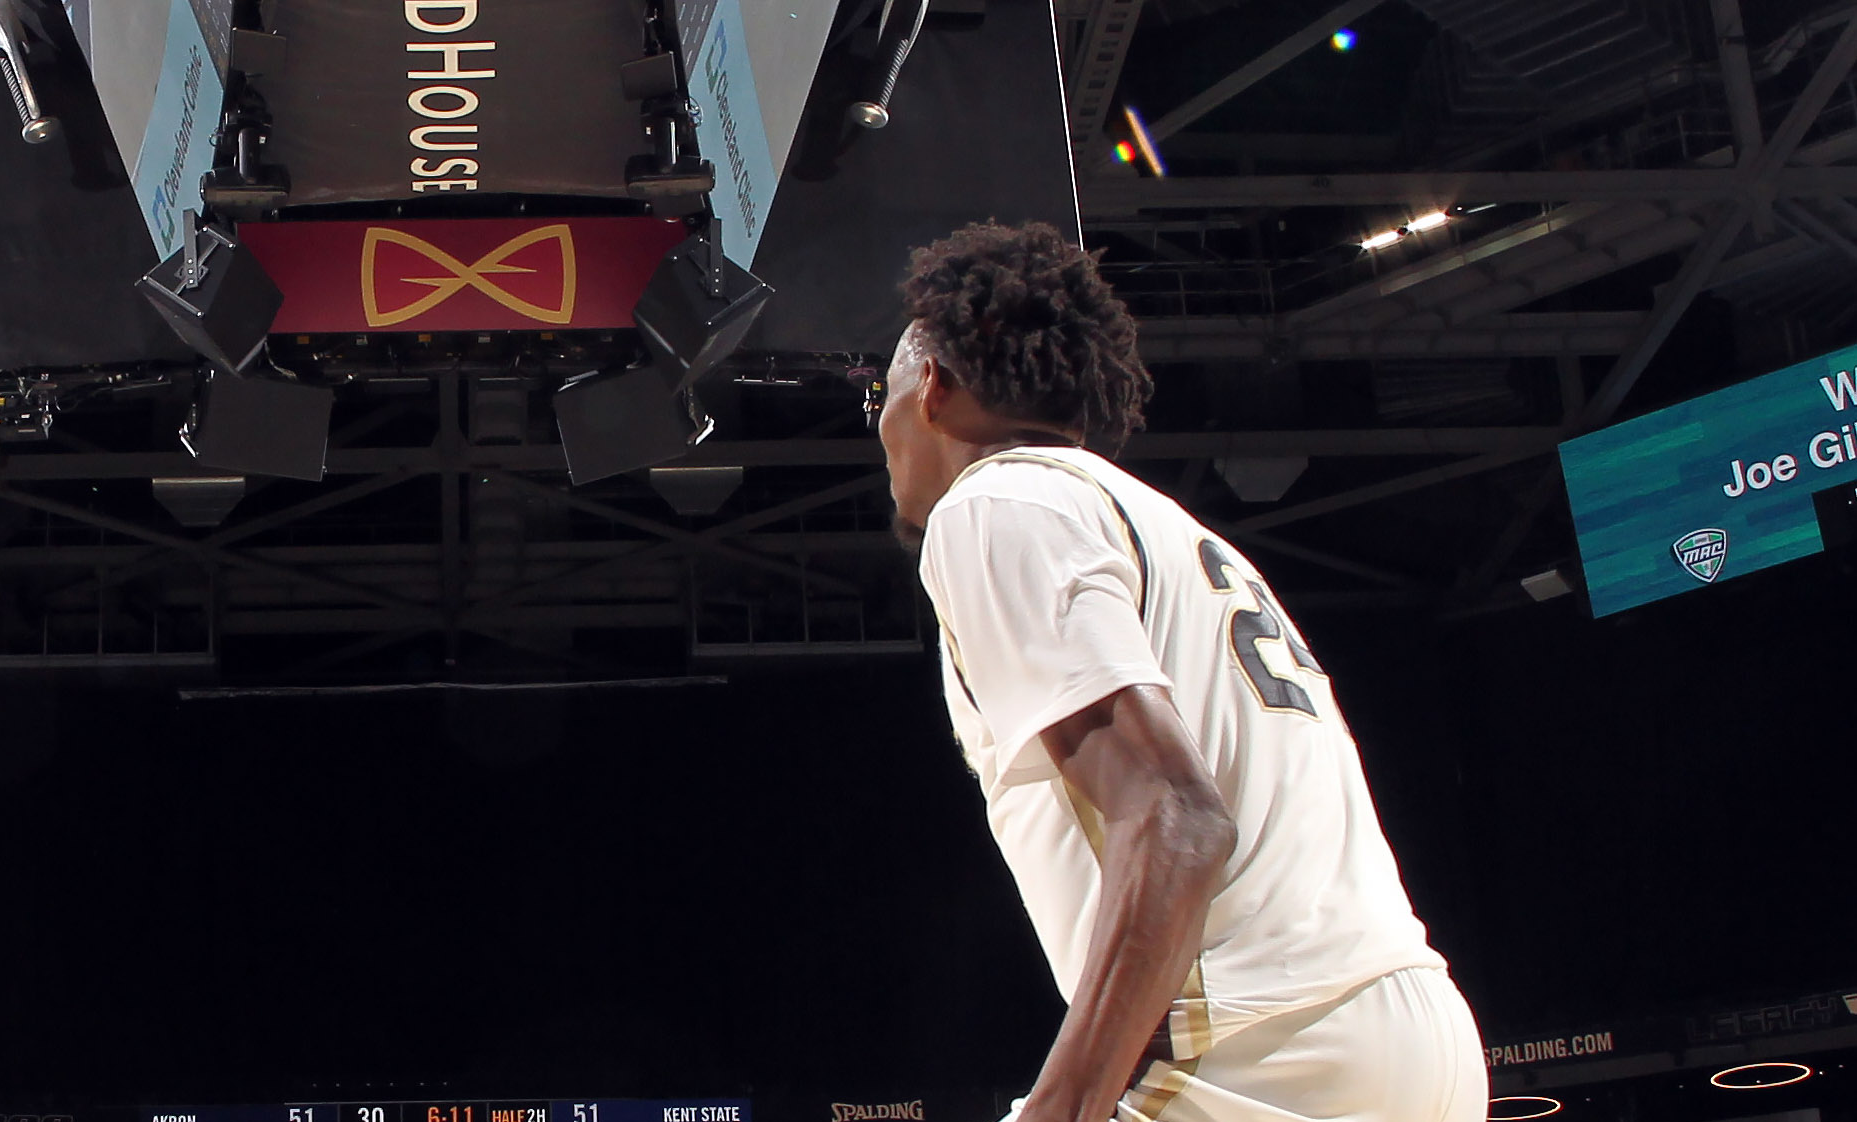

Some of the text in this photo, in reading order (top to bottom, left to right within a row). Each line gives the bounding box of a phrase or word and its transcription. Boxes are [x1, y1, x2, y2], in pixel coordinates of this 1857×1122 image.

[163, 44, 203, 208] Cleveland Clinic
[716, 70, 756, 239] Cleveland Clinic
[1722, 422, 1857, 498] Joe Gi
[1682, 541, 1724, 566] MAC
[663, 1106, 696, 1122] KENT
[700, 1106, 740, 1122] STATE
